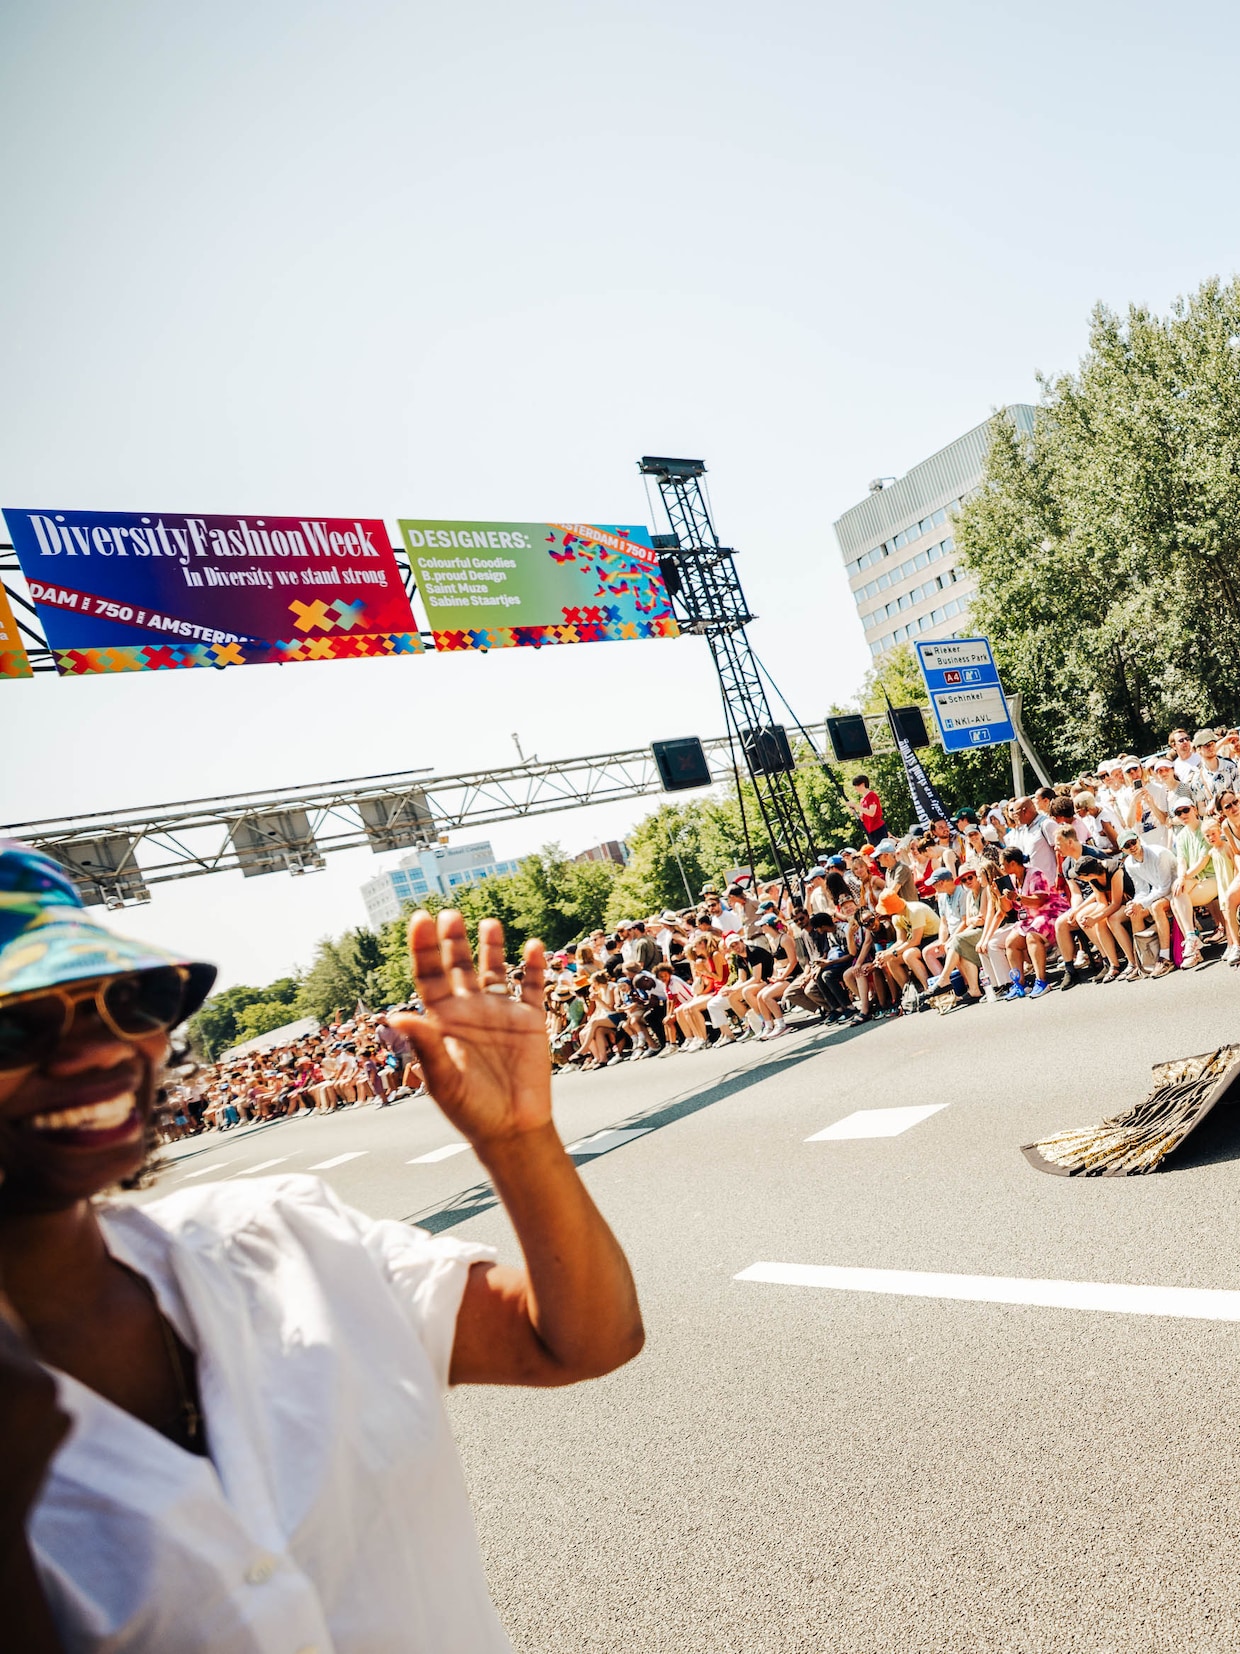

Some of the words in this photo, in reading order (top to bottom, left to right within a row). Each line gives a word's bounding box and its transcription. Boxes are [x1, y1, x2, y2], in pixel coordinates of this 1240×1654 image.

[27, 514, 380, 565] DiversityFashionWeek
[408, 529, 532, 549] DESIGNERS:
[625, 543, 647, 559] 750
[417, 557, 471, 569] Colourful
[472, 557, 517, 569] Goodies
[182, 566, 204, 587] In
[203, 566, 274, 590] Diversity
[275, 571, 300, 586] we
[301, 566, 341, 585] stand
[342, 567, 389, 588] strong
[422, 570, 468, 583] B.proud
[469, 570, 507, 584] Design
[425, 583, 457, 594] Saint
[457, 583, 488, 593] Muze
[429, 596, 469, 607] Sabine
[470, 595, 521, 608] Staartjes
[95, 600, 134, 621] 750
[934, 646, 960, 655] Rieker
[937, 656, 970, 665] Business
[971, 654, 988, 663] Park
[947, 672, 960, 682] A4
[948, 692, 983, 704] Schinkel
[955, 714, 991, 726] NKI-AVL
